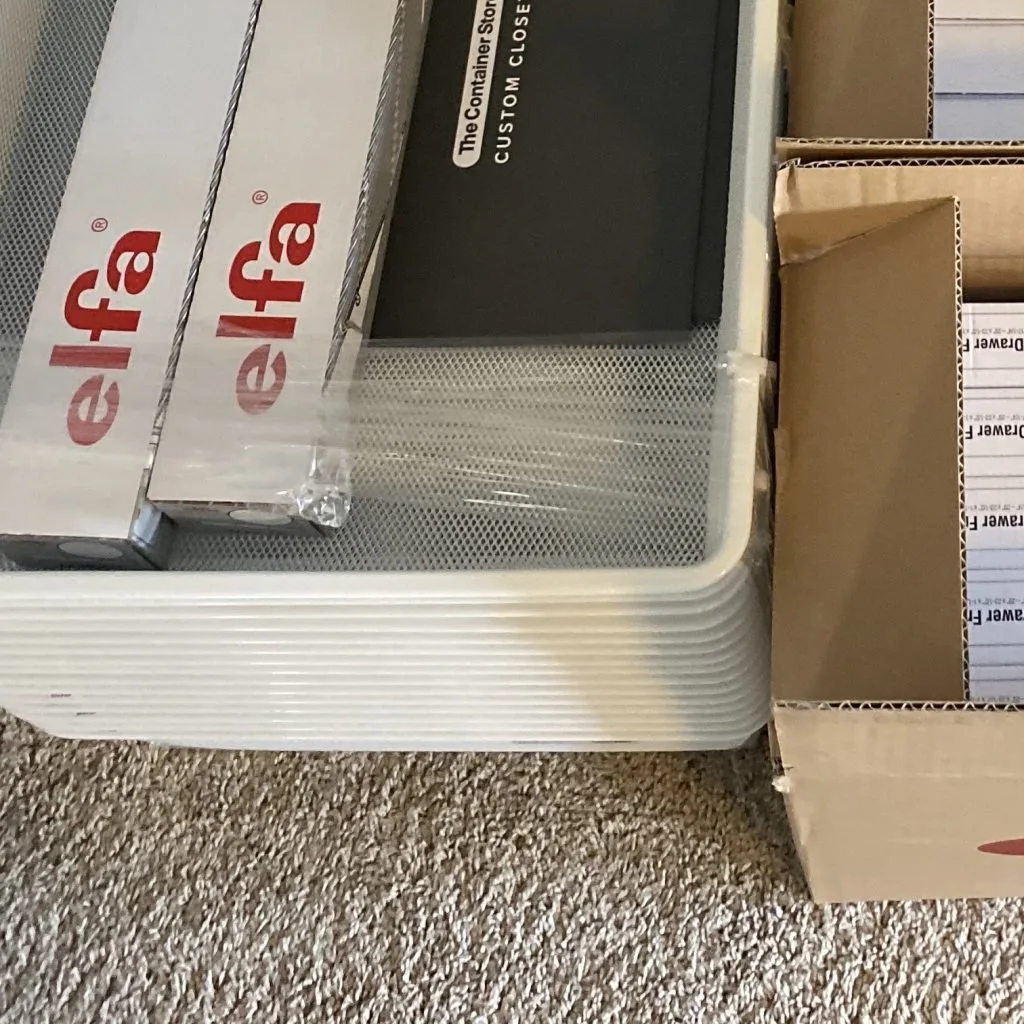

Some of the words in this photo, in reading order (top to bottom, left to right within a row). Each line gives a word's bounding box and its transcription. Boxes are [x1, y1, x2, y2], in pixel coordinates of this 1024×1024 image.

[464, 36, 491, 121] Container
[459, 124, 478, 155] The
[494, 77, 520, 164] CUSTOM
[974, 338, 1024, 352] Drawer
